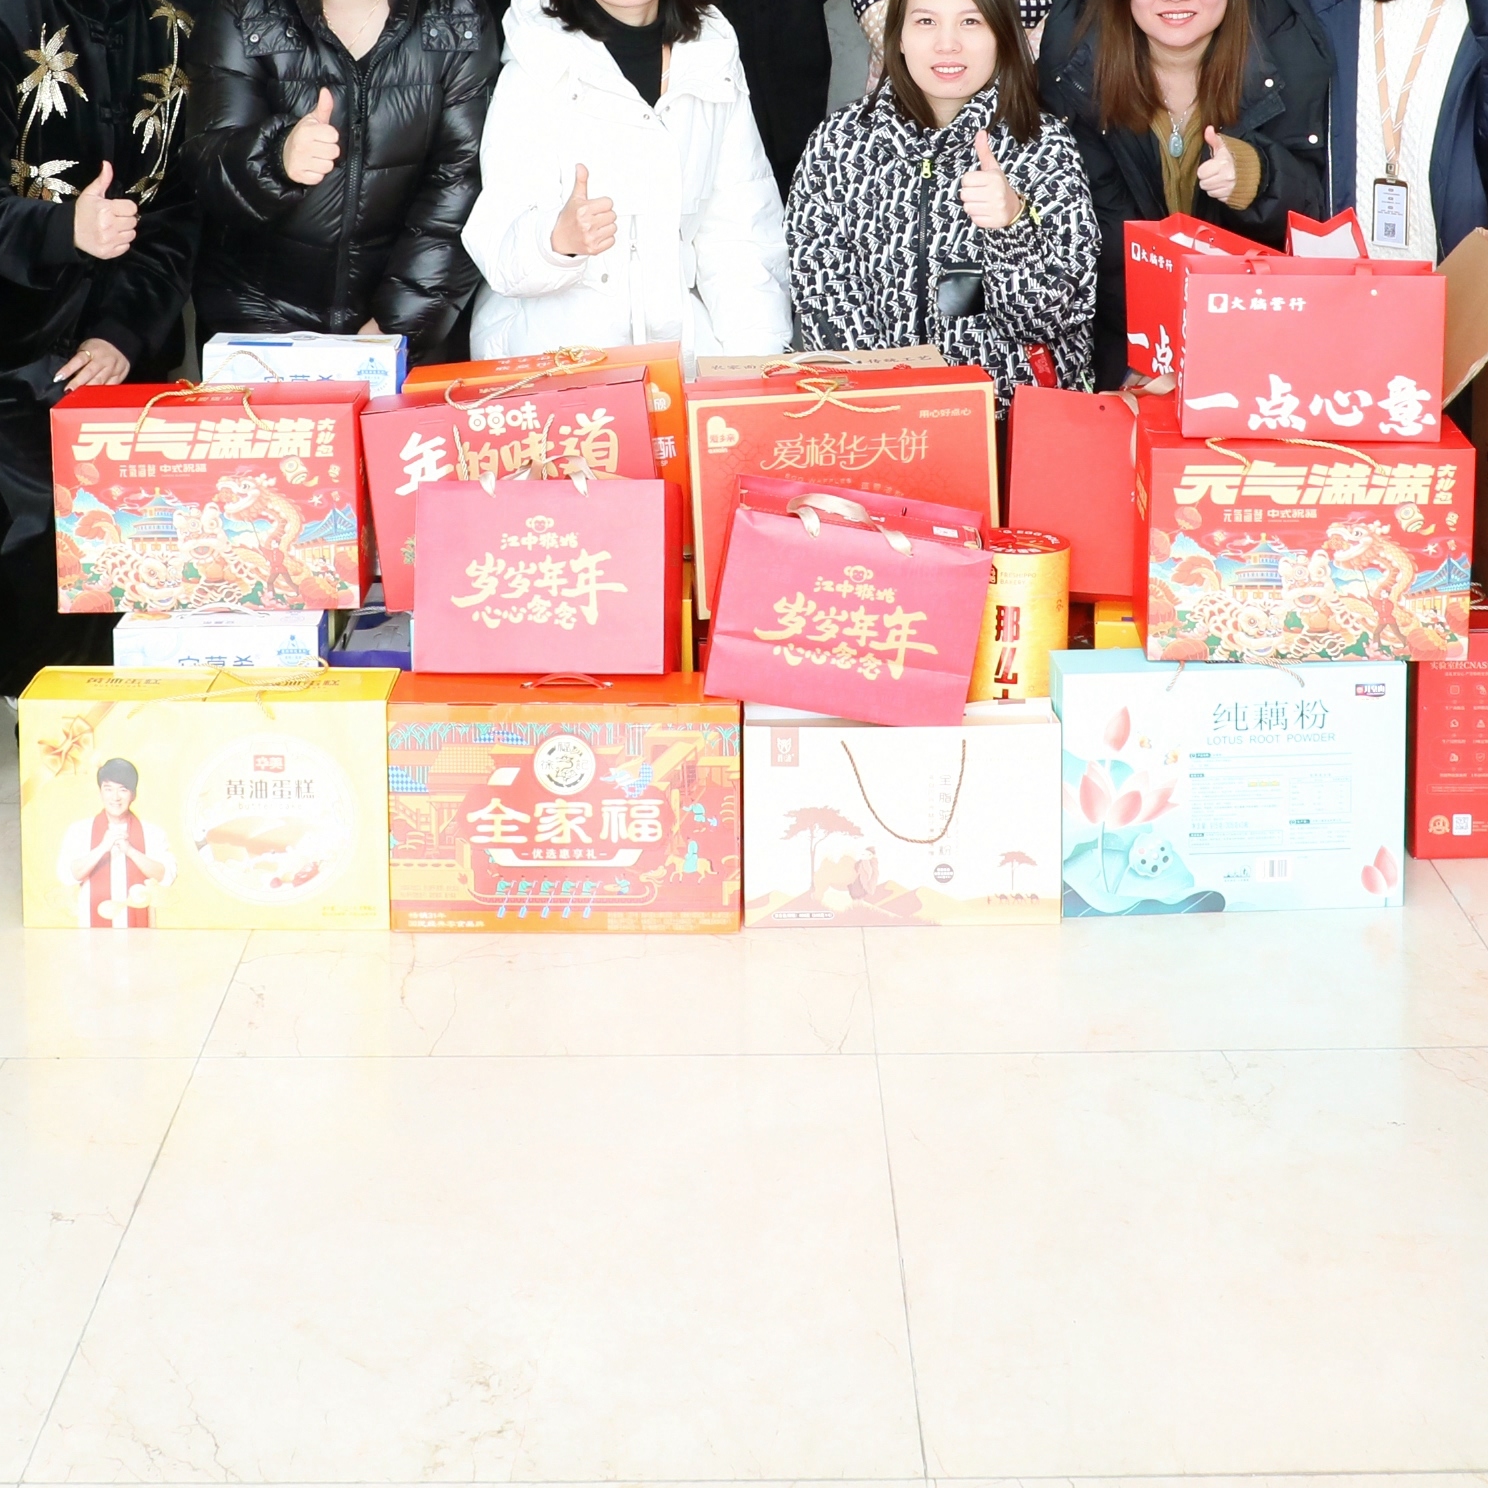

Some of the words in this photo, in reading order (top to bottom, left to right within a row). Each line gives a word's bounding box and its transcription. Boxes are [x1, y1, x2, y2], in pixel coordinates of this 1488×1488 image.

[1231, 297, 1306, 312] 大脑营行
[467, 400, 541, 436] 百草味
[919, 408, 971, 419] 用心好点心
[1184, 373, 1437, 436] 一点心意
[71, 417, 314, 461] 元气满满
[315, 417, 336, 458] 大礼包
[394, 407, 630, 497] 年的味道
[760, 428, 928, 471] 爱格华夫饼
[1173, 459, 1436, 505] 元气满满
[1433, 463, 1458, 505] 大礼包
[450, 548, 629, 626] 岁岁年年
[472, 594, 577, 631] 心心念念
[753, 591, 939, 680] 岁岁年年
[773, 641, 883, 681] 心心念念
[1213, 699, 1330, 732] 纯藕粉
[1207, 735, 1243, 746] LOTUS
[1250, 734, 1281, 744] ROOT
[1286, 732, 1336, 743] POWDER
[225, 779, 315, 799] 黄油蛋糕
[466, 798, 664, 844] 全家福
